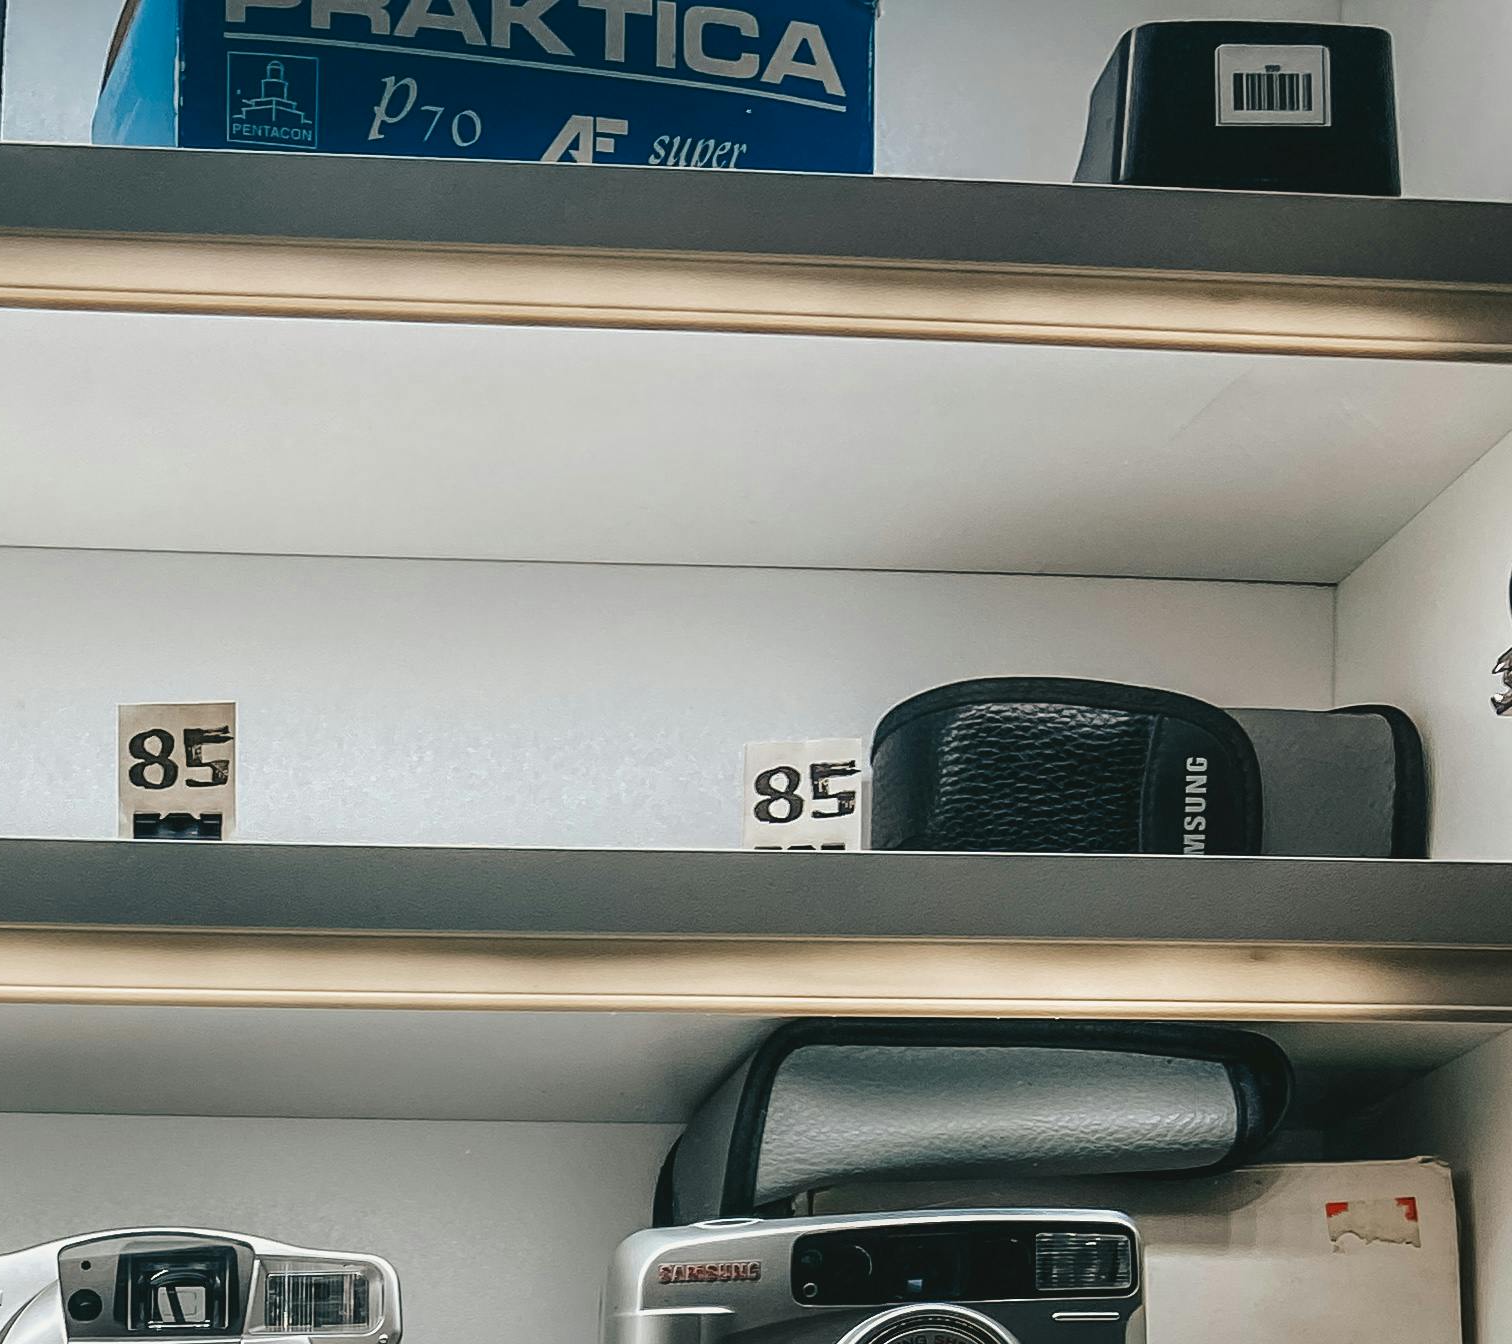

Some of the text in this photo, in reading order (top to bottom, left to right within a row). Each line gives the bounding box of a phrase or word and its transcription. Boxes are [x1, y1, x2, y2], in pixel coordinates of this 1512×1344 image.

[231, 122, 313, 142] PENTACON
[647, 132, 748, 169] super
[128, 725, 235, 789] 85
[753, 759, 861, 824] 85
[1183, 757, 1208, 855] MSUNG
[657, 1260, 763, 1284] SAMSUNG
